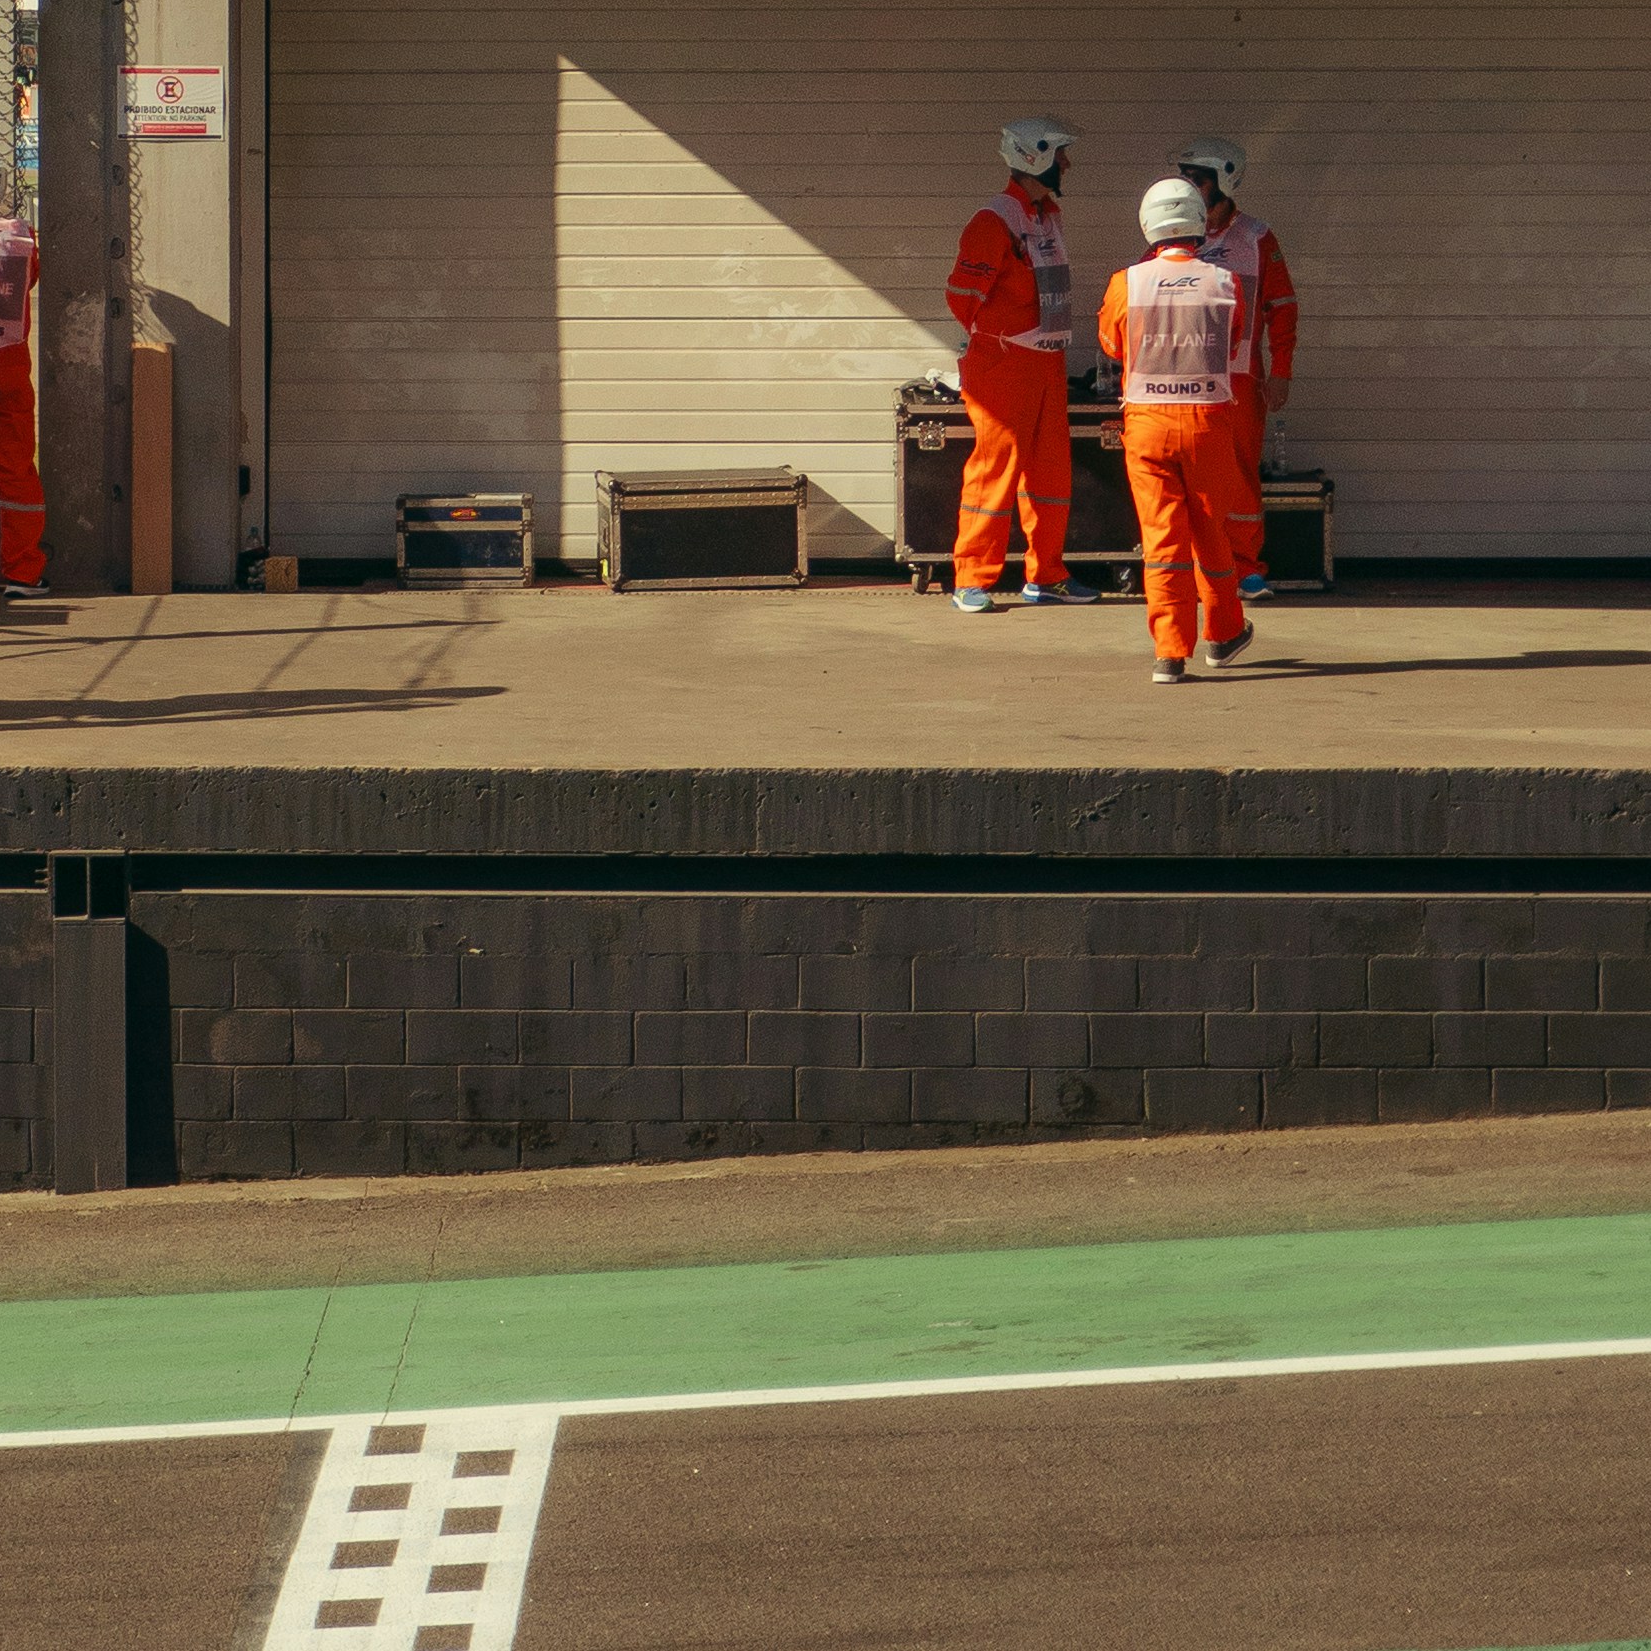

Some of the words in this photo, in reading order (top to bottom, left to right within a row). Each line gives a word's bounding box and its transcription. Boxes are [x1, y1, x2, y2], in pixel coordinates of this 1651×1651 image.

[124, 105, 163, 114] PROIBIDO
[165, 105, 216, 114] ESTACIONAR
[1158, 277, 1201, 287] WEC
[1142, 333, 1167, 347] PIT
[1172, 333, 1216, 347] LANE
[1146, 382, 1201, 395] ROUND
[1206, 381, 1216, 393] 5
